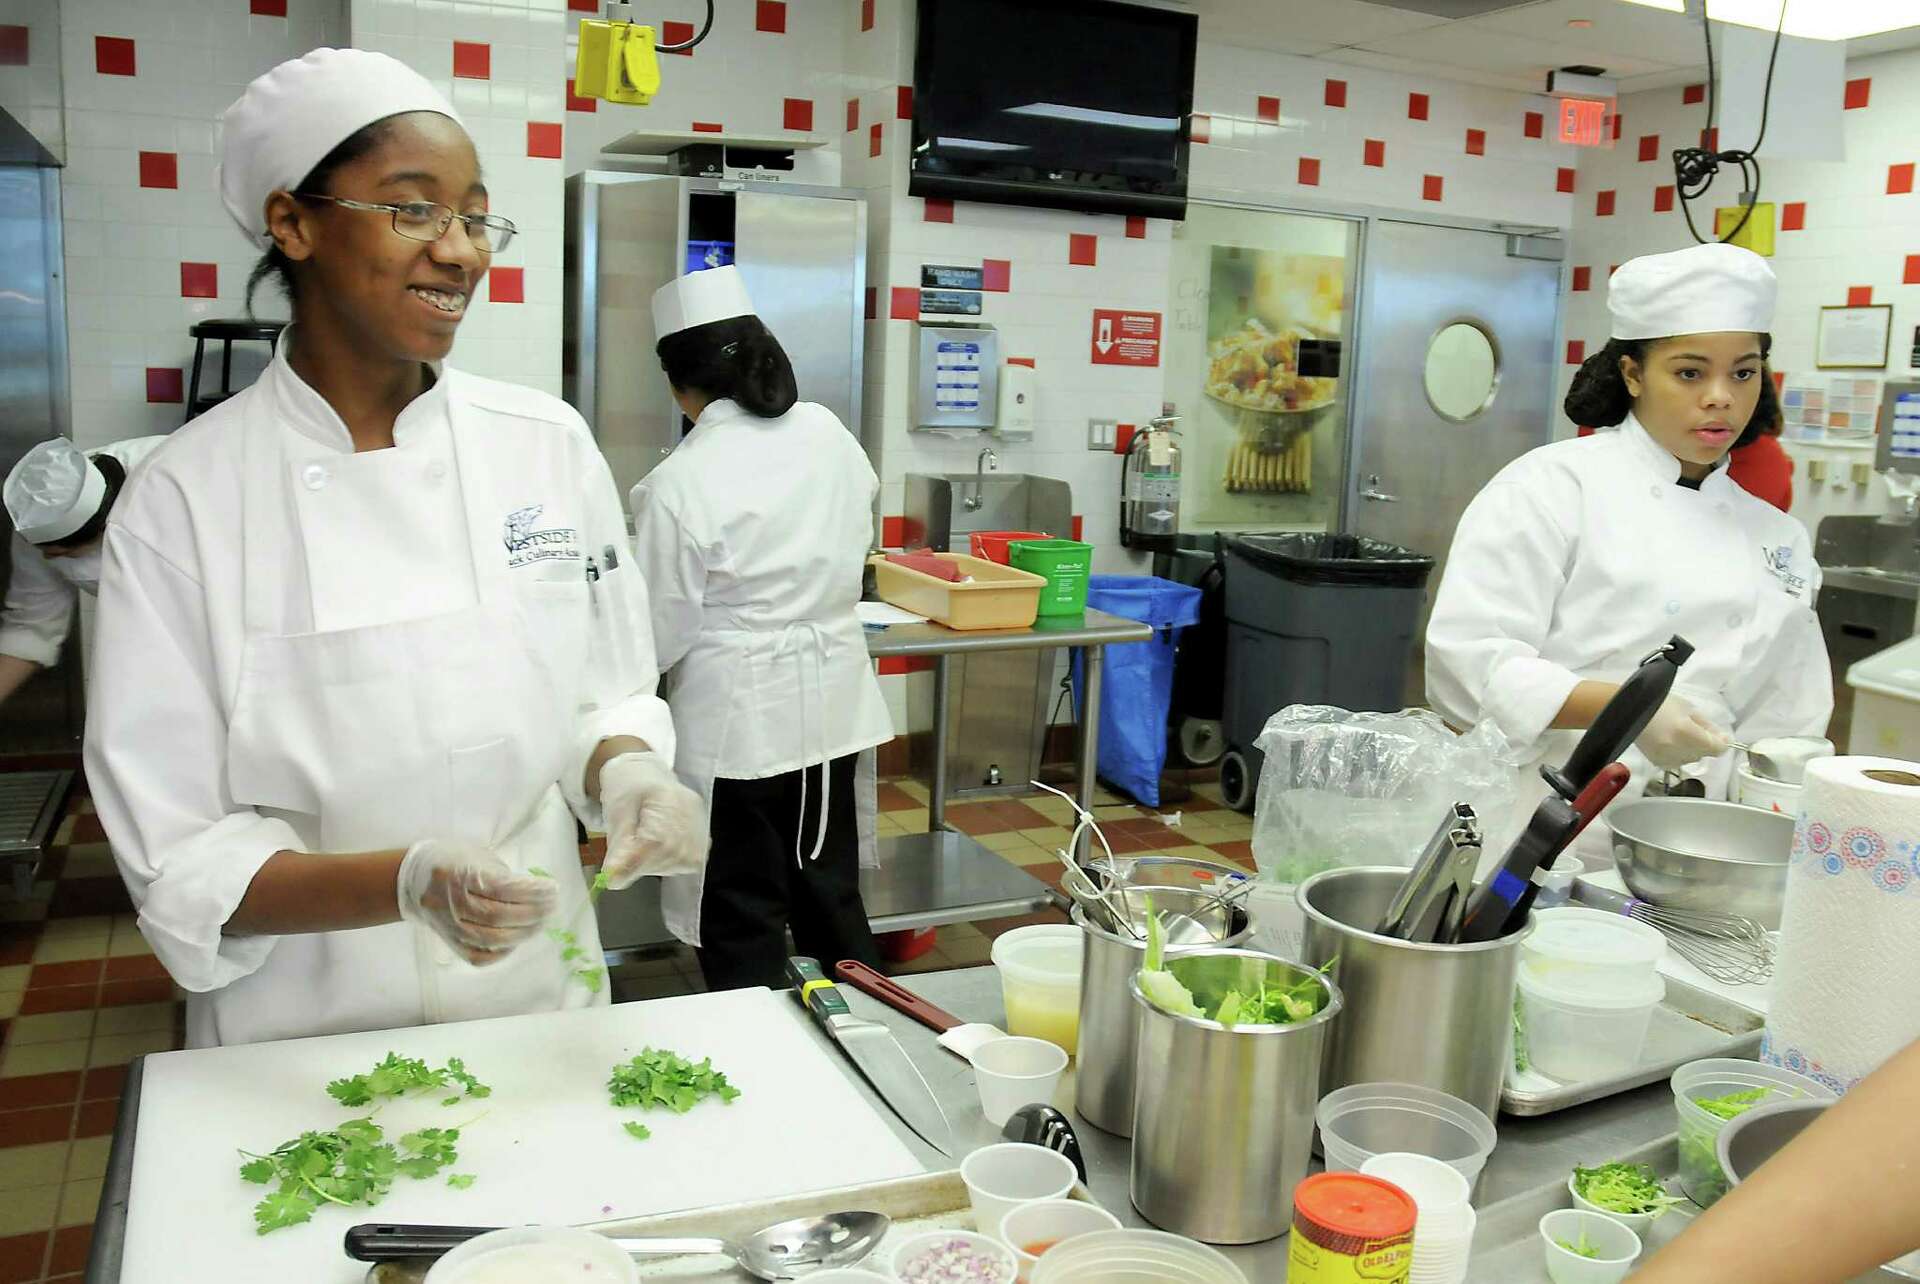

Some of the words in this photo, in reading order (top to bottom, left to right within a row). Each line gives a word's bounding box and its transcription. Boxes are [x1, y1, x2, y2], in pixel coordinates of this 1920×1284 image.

[1560, 99, 1605, 145] EXIT
[738, 172, 753, 180] Can
[755, 172, 779, 182] liners
[954, 270, 978, 280] WASH
